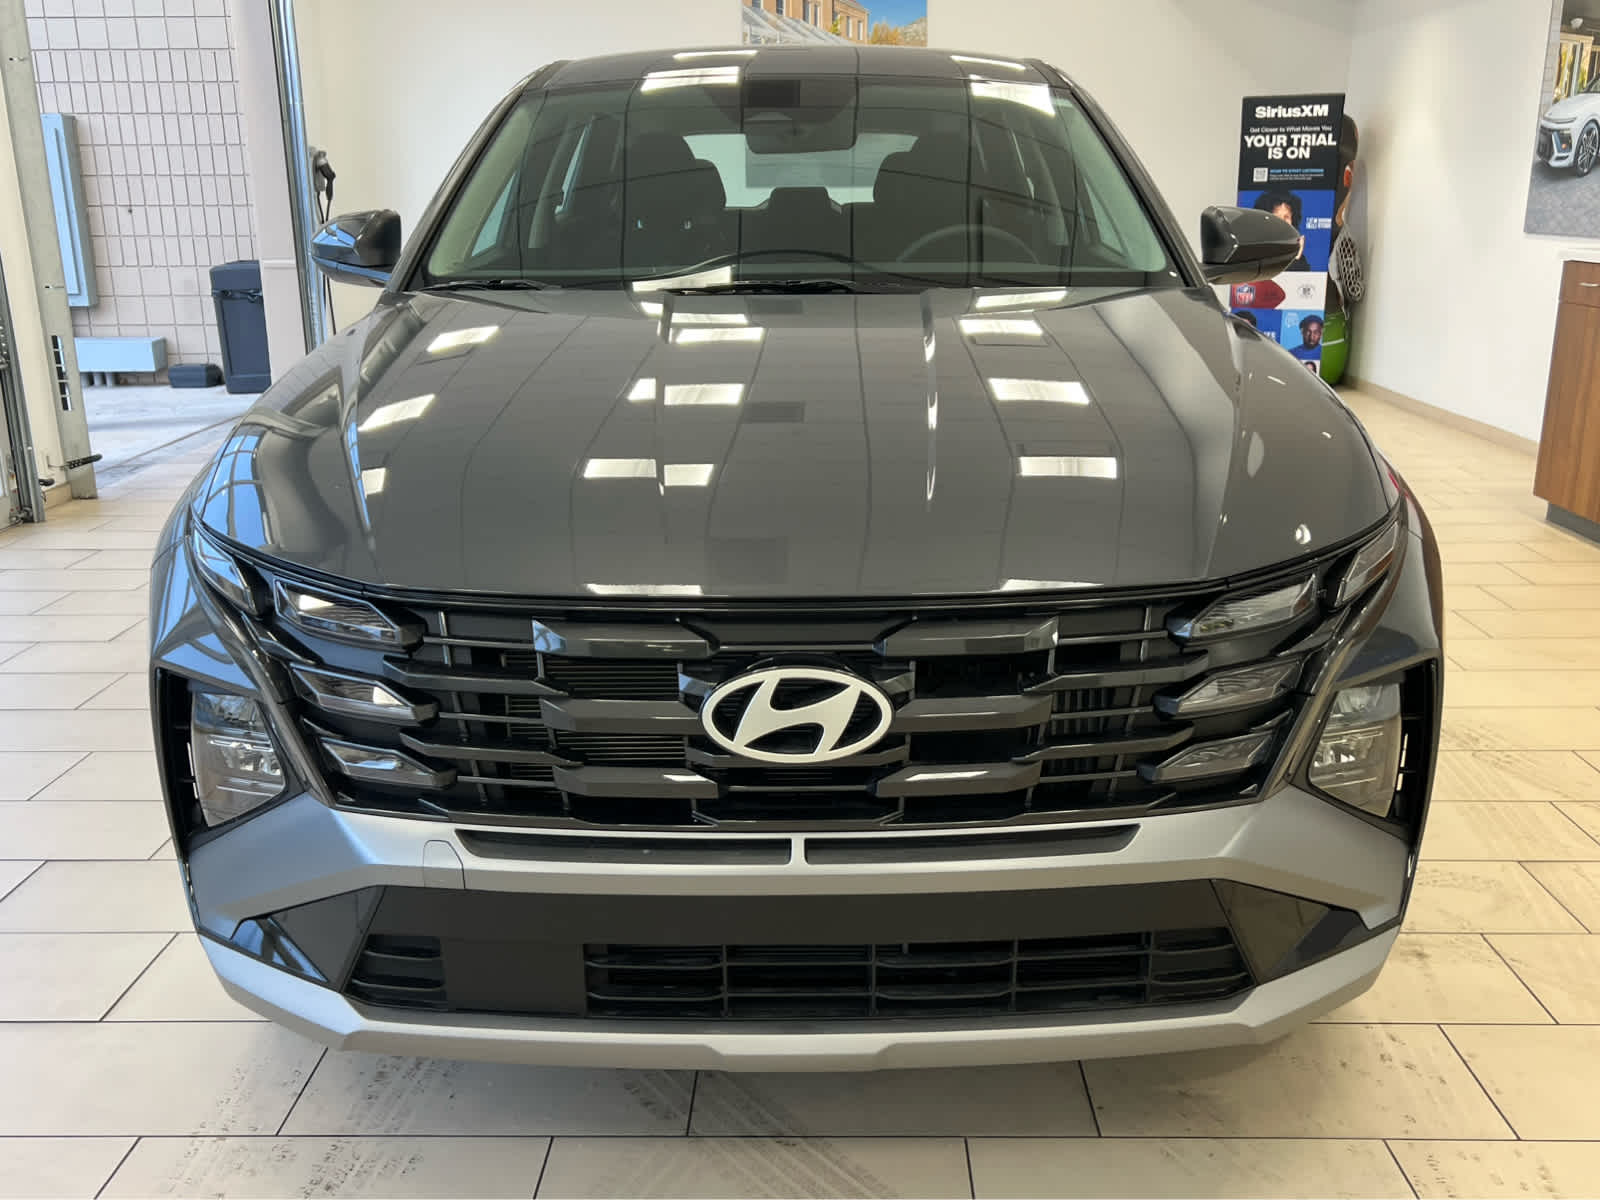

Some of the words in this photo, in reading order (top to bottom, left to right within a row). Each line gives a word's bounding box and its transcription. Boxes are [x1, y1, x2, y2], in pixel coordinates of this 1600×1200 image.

[1255, 104, 1329, 119] SiriusXM
[1244, 134, 1287, 148] YOUR
[1290, 133, 1337, 147] TRIAL
[1267, 147, 1283, 159] IS
[1286, 147, 1310, 159] ON
